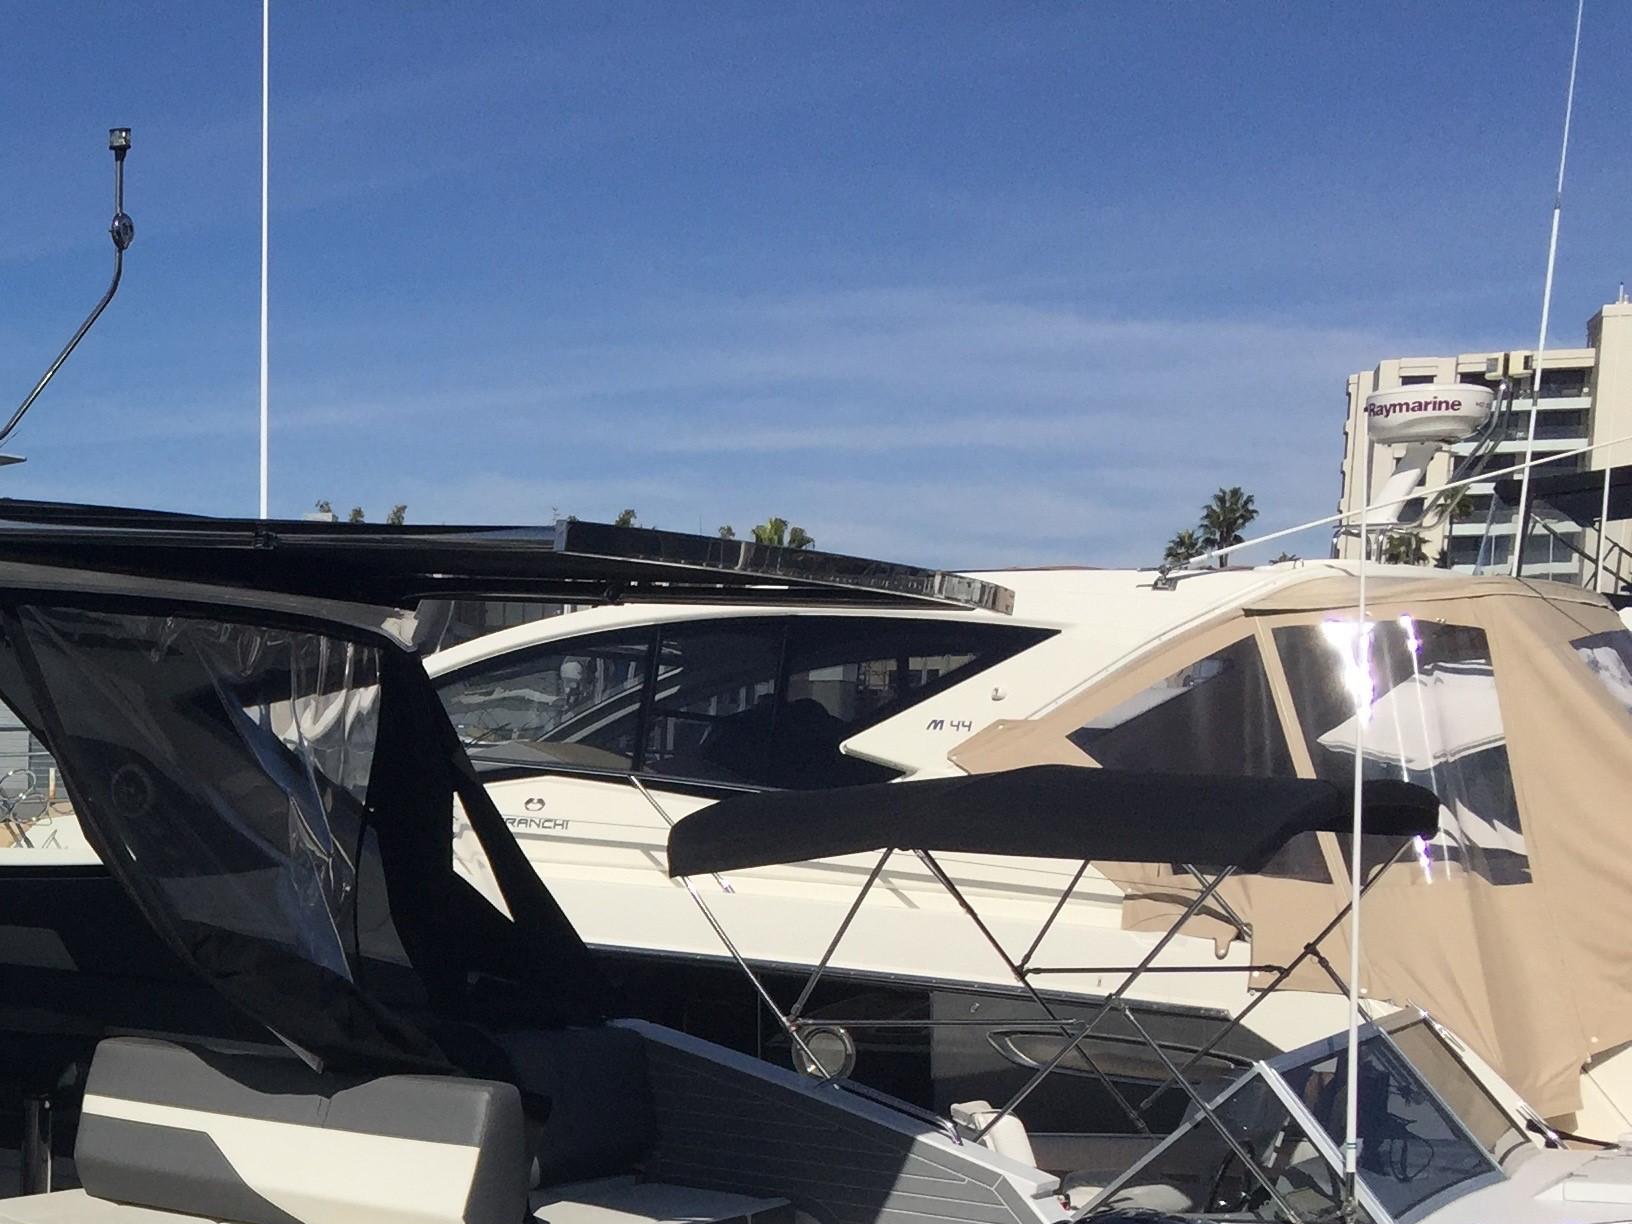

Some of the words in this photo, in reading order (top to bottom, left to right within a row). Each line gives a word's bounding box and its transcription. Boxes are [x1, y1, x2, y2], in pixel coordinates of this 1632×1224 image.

[1369, 396, 1462, 418] Raymarine
[926, 719, 945, 731] M
[949, 719, 972, 732] 44
[503, 817, 570, 830] RANCHI
